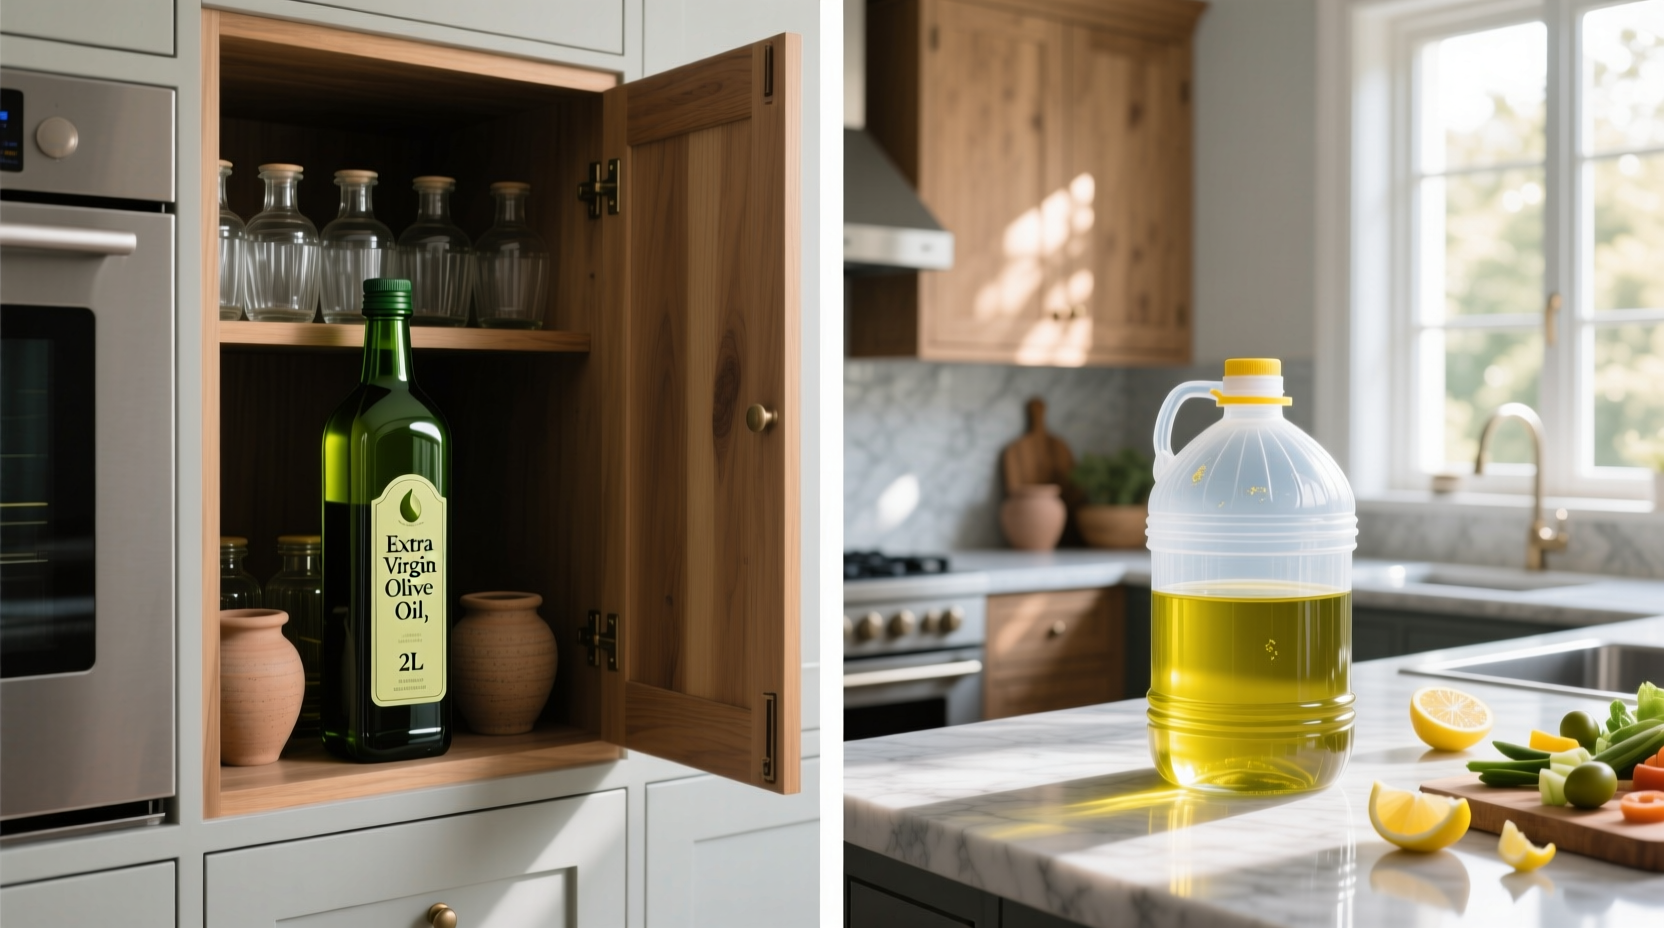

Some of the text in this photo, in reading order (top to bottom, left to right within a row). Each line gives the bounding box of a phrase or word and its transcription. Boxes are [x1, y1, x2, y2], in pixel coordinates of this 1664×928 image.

[386, 535, 433, 553] Extra
[383, 556, 437, 578] Virgin
[385, 578, 433, 597] Olive
[395, 600, 429, 623] Oil,
[398, 652, 424, 672] 2L
